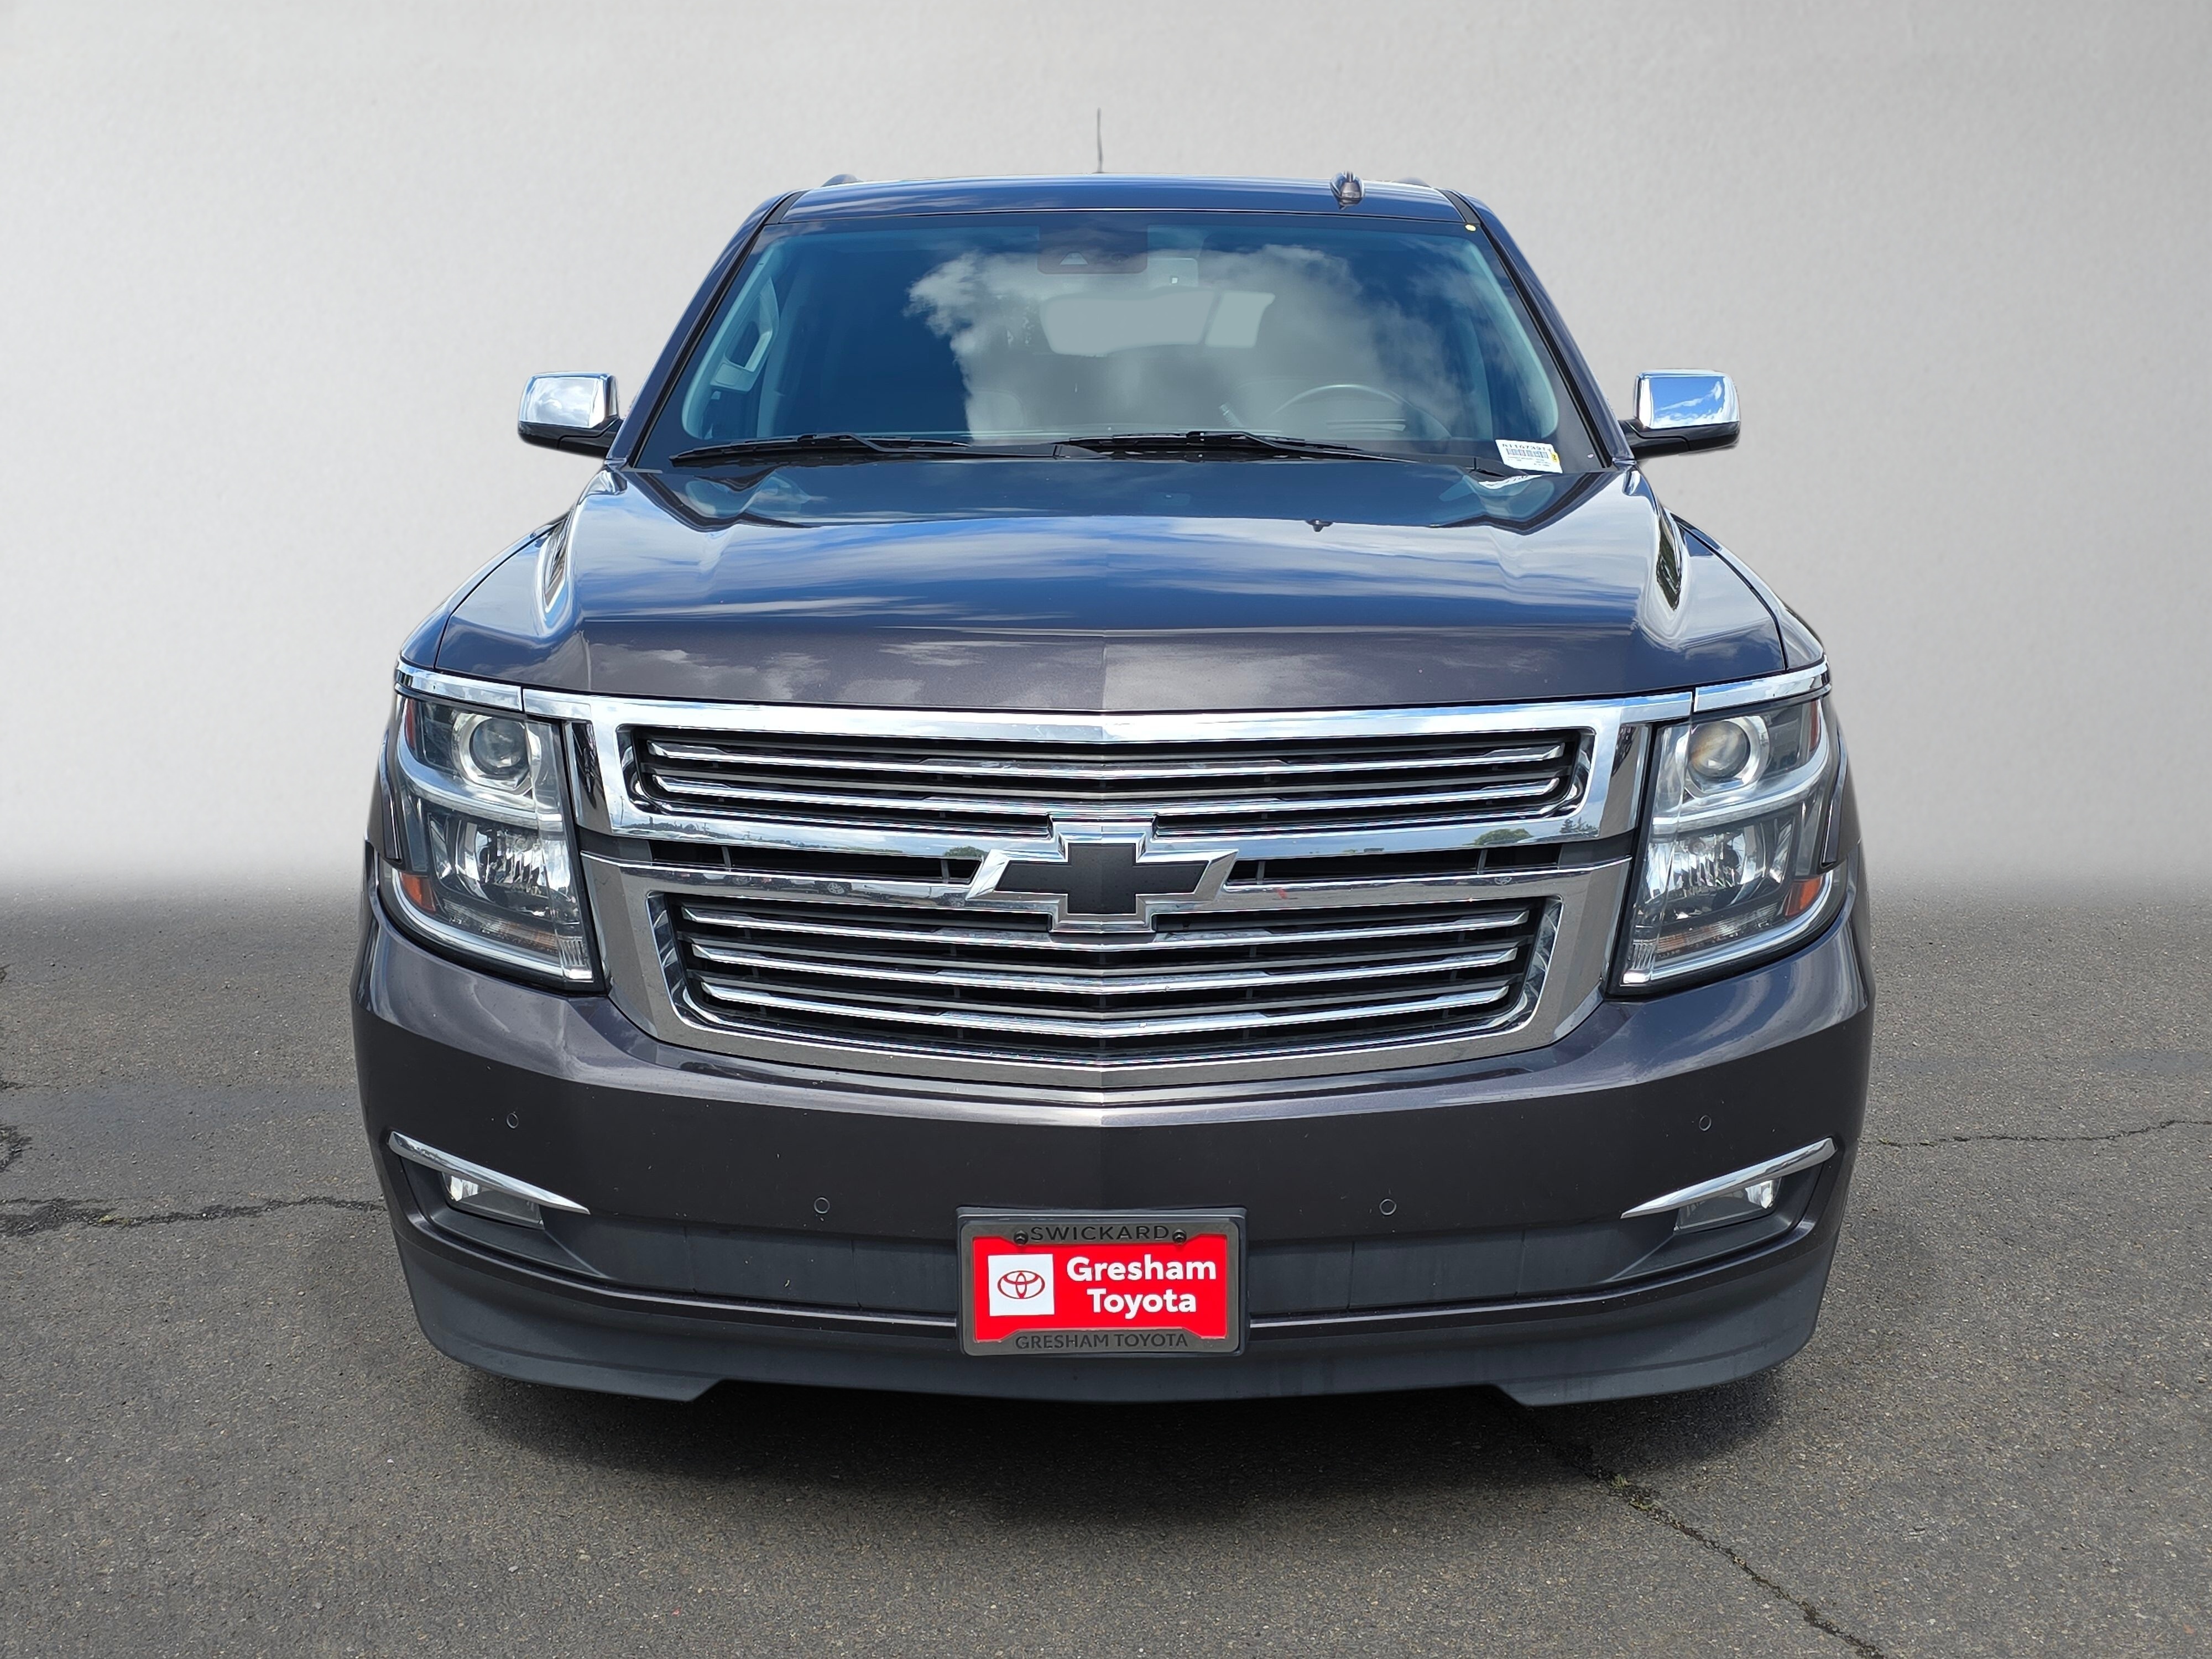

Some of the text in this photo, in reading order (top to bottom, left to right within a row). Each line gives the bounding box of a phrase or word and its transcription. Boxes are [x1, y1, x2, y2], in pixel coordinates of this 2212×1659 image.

[1030, 1225, 1170, 1241] SWICKARD
[1067, 1254, 1217, 1281] Gresham
[1087, 1288, 1197, 1319] Toyota
[1015, 1333, 1188, 1349] GRESHAM TOYOTA
